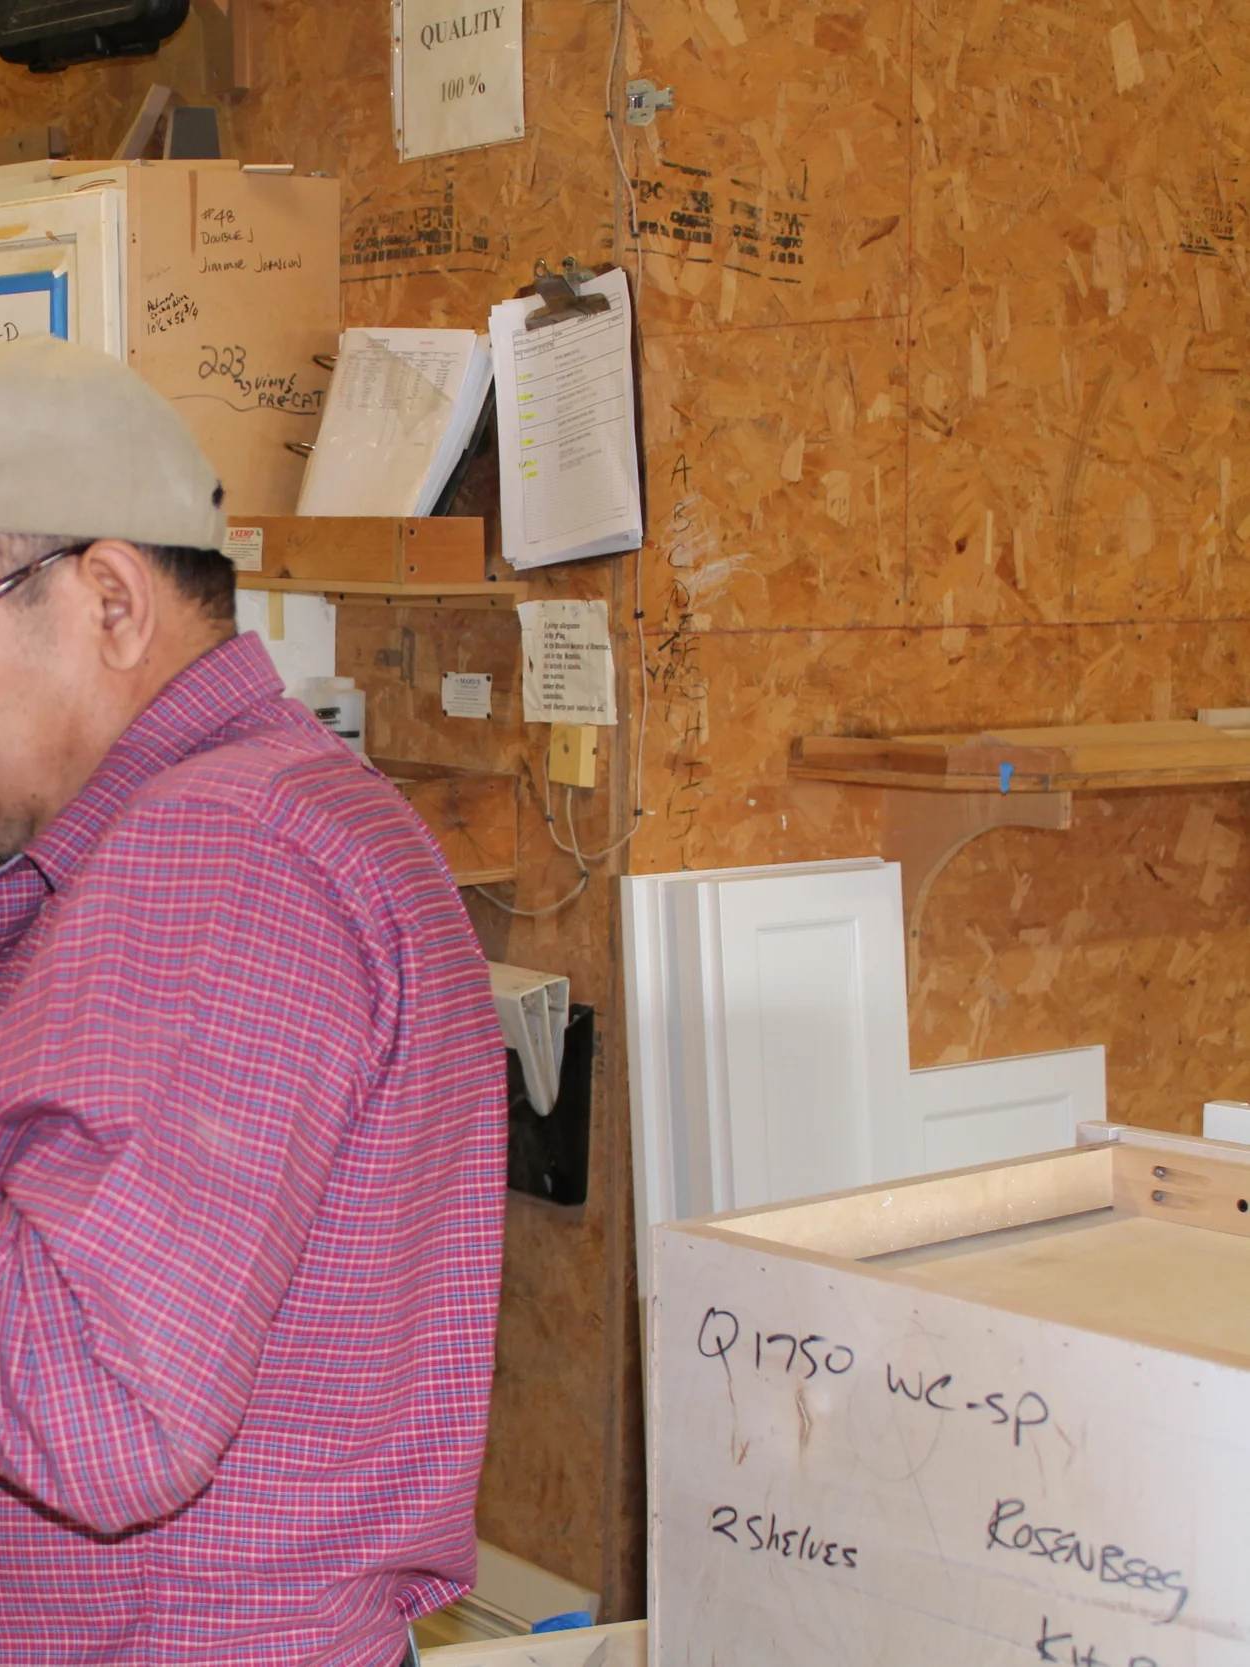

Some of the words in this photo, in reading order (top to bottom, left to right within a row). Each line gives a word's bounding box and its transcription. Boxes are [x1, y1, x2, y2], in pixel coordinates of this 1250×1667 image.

[420, 6, 505, 51] QUALITY
[201, 208, 236, 229] #48
[200, 230, 244, 245] DOUBLE
[247, 227, 254, 243] J
[198, 345, 247, 379] 223
[670, 454, 693, 492] A
[673, 502, 691, 533] B
[667, 543, 696, 569] C
